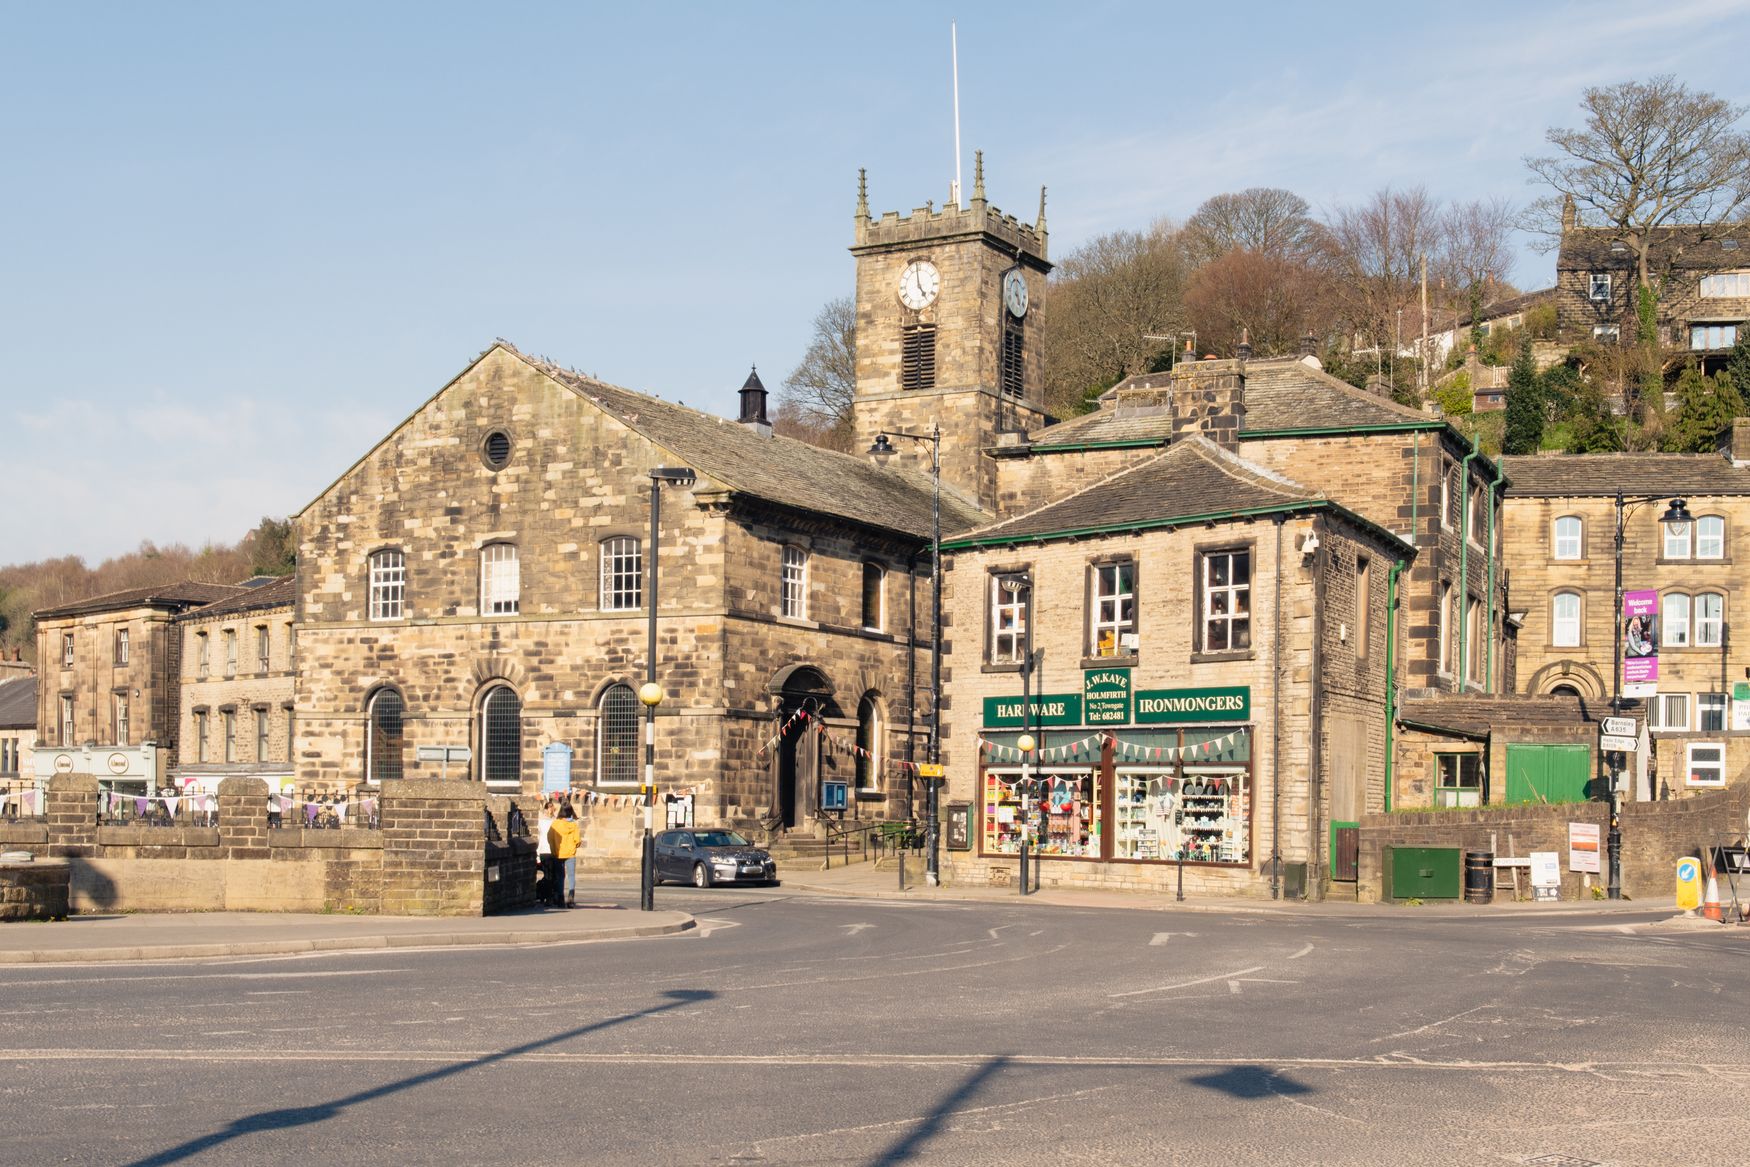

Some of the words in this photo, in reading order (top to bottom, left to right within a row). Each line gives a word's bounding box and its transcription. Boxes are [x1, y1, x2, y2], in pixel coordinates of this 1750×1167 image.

[1628, 599, 1653, 607] Welcome
[1086, 691, 1127, 700] HOLMFIRTH
[1101, 702, 1124, 710] Towngate
[1139, 695, 1244, 713] IRONMONGERS
[1088, 712, 1101, 720] Tel:
[1102, 711, 1125, 720] 682481
[1611, 719, 1634, 728] Barnsley
